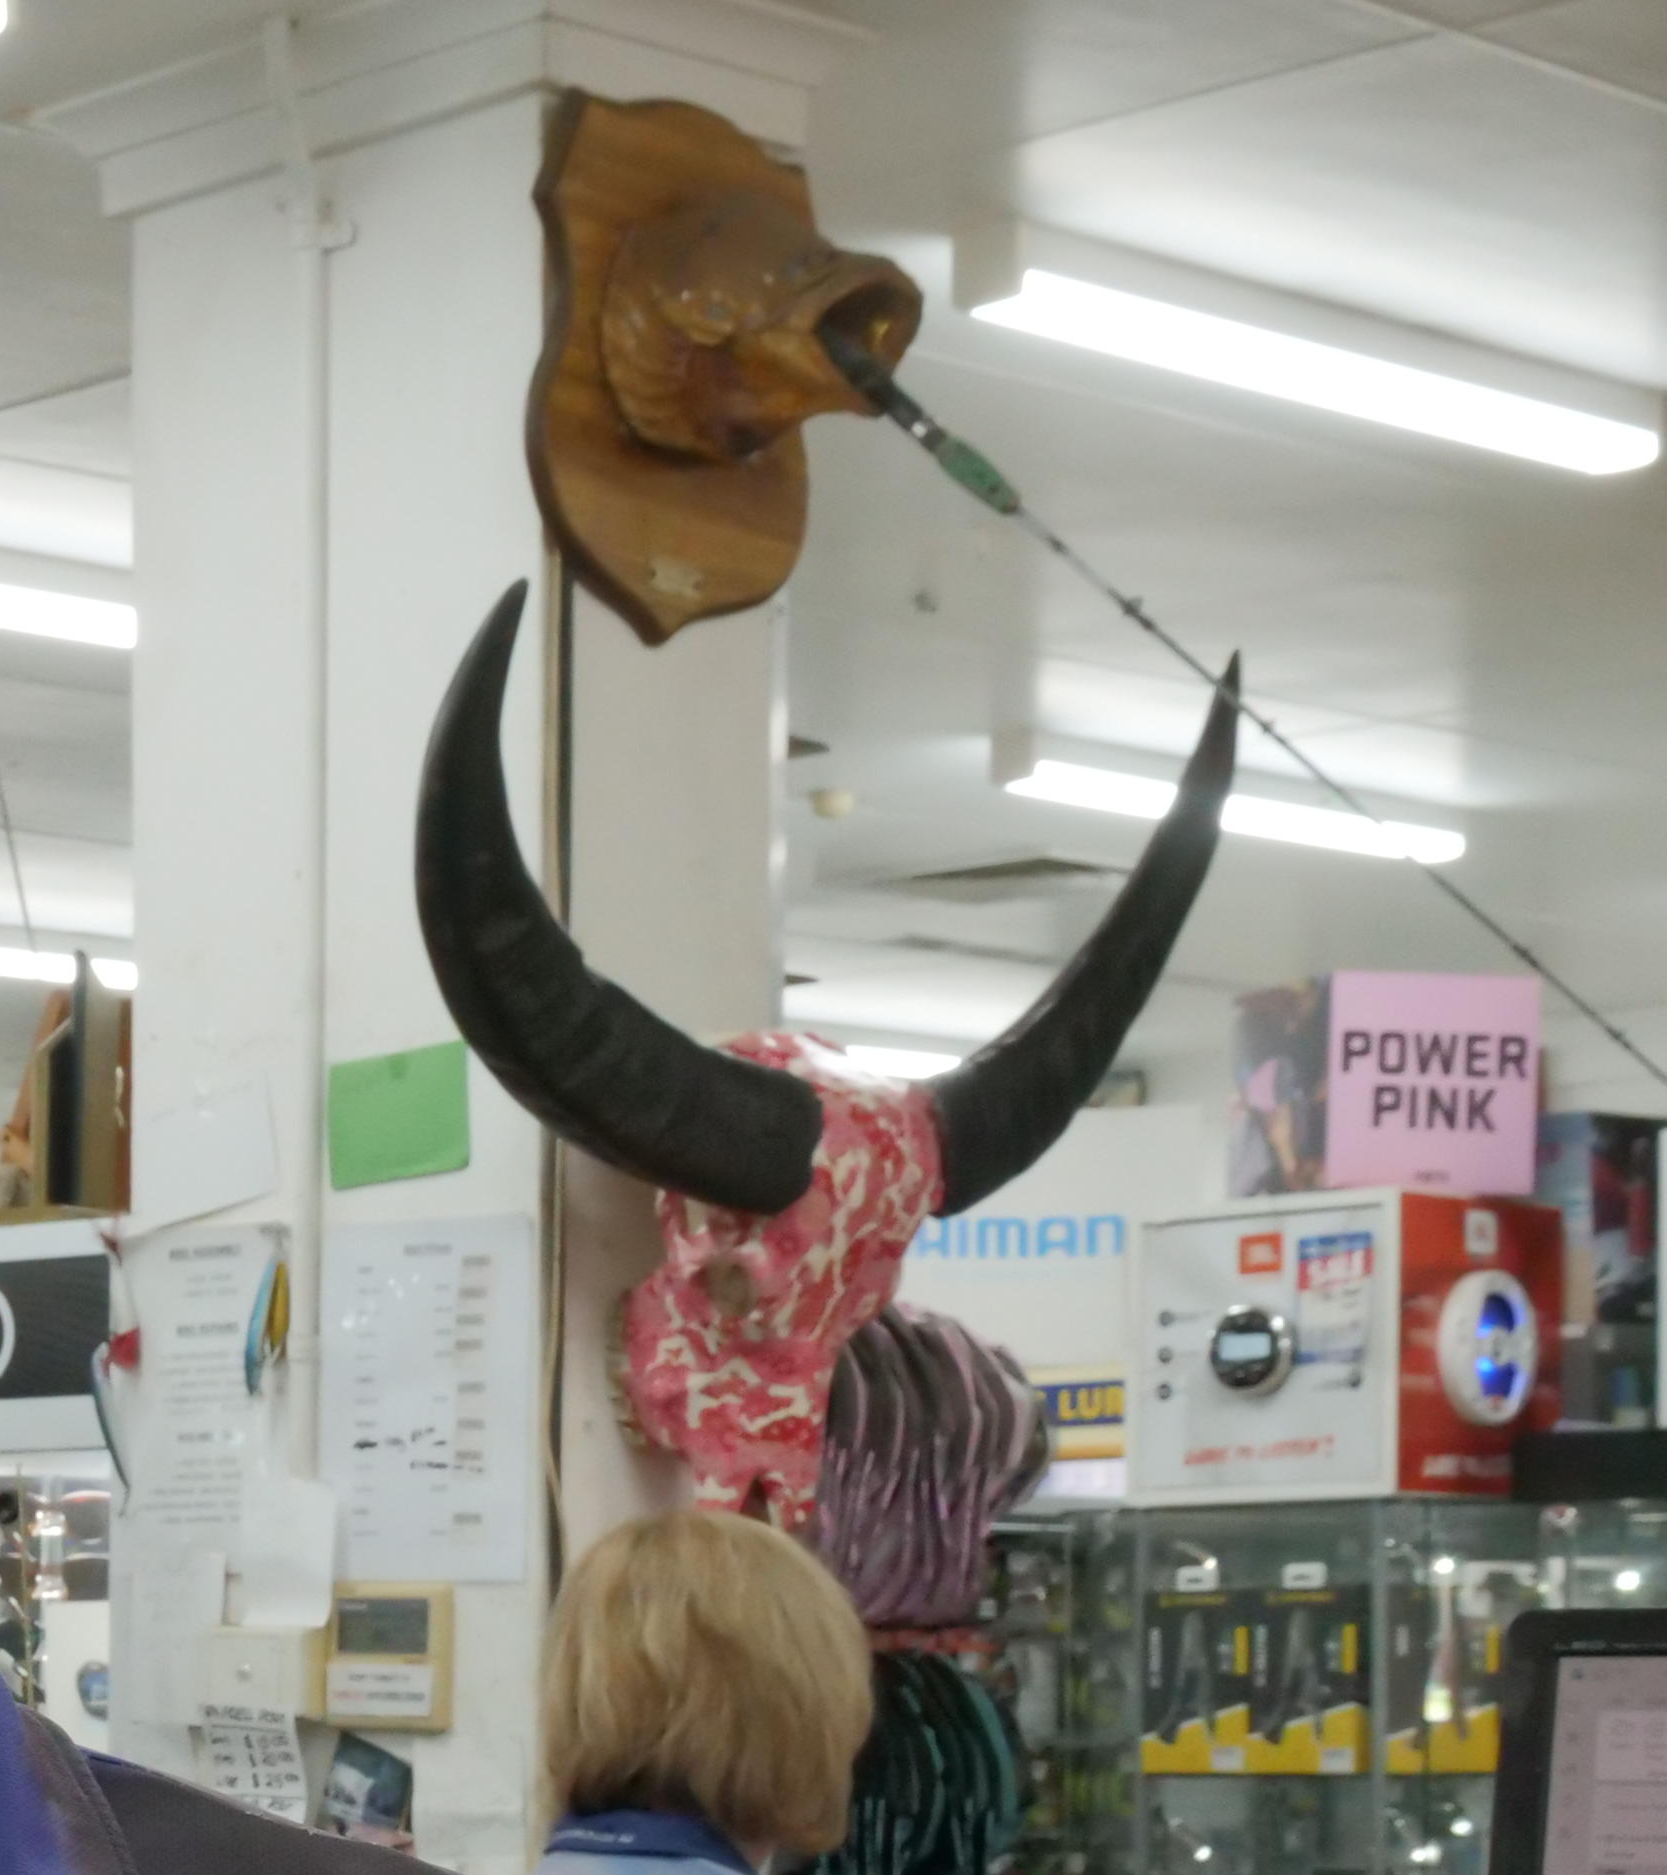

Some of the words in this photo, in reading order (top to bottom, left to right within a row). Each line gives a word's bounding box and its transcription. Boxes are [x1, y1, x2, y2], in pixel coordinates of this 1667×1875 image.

[1341, 1030, 1528, 1079] POWER
[1372, 1085, 1497, 1132] PINK
[910, 1214, 1126, 1259] HIMAN
